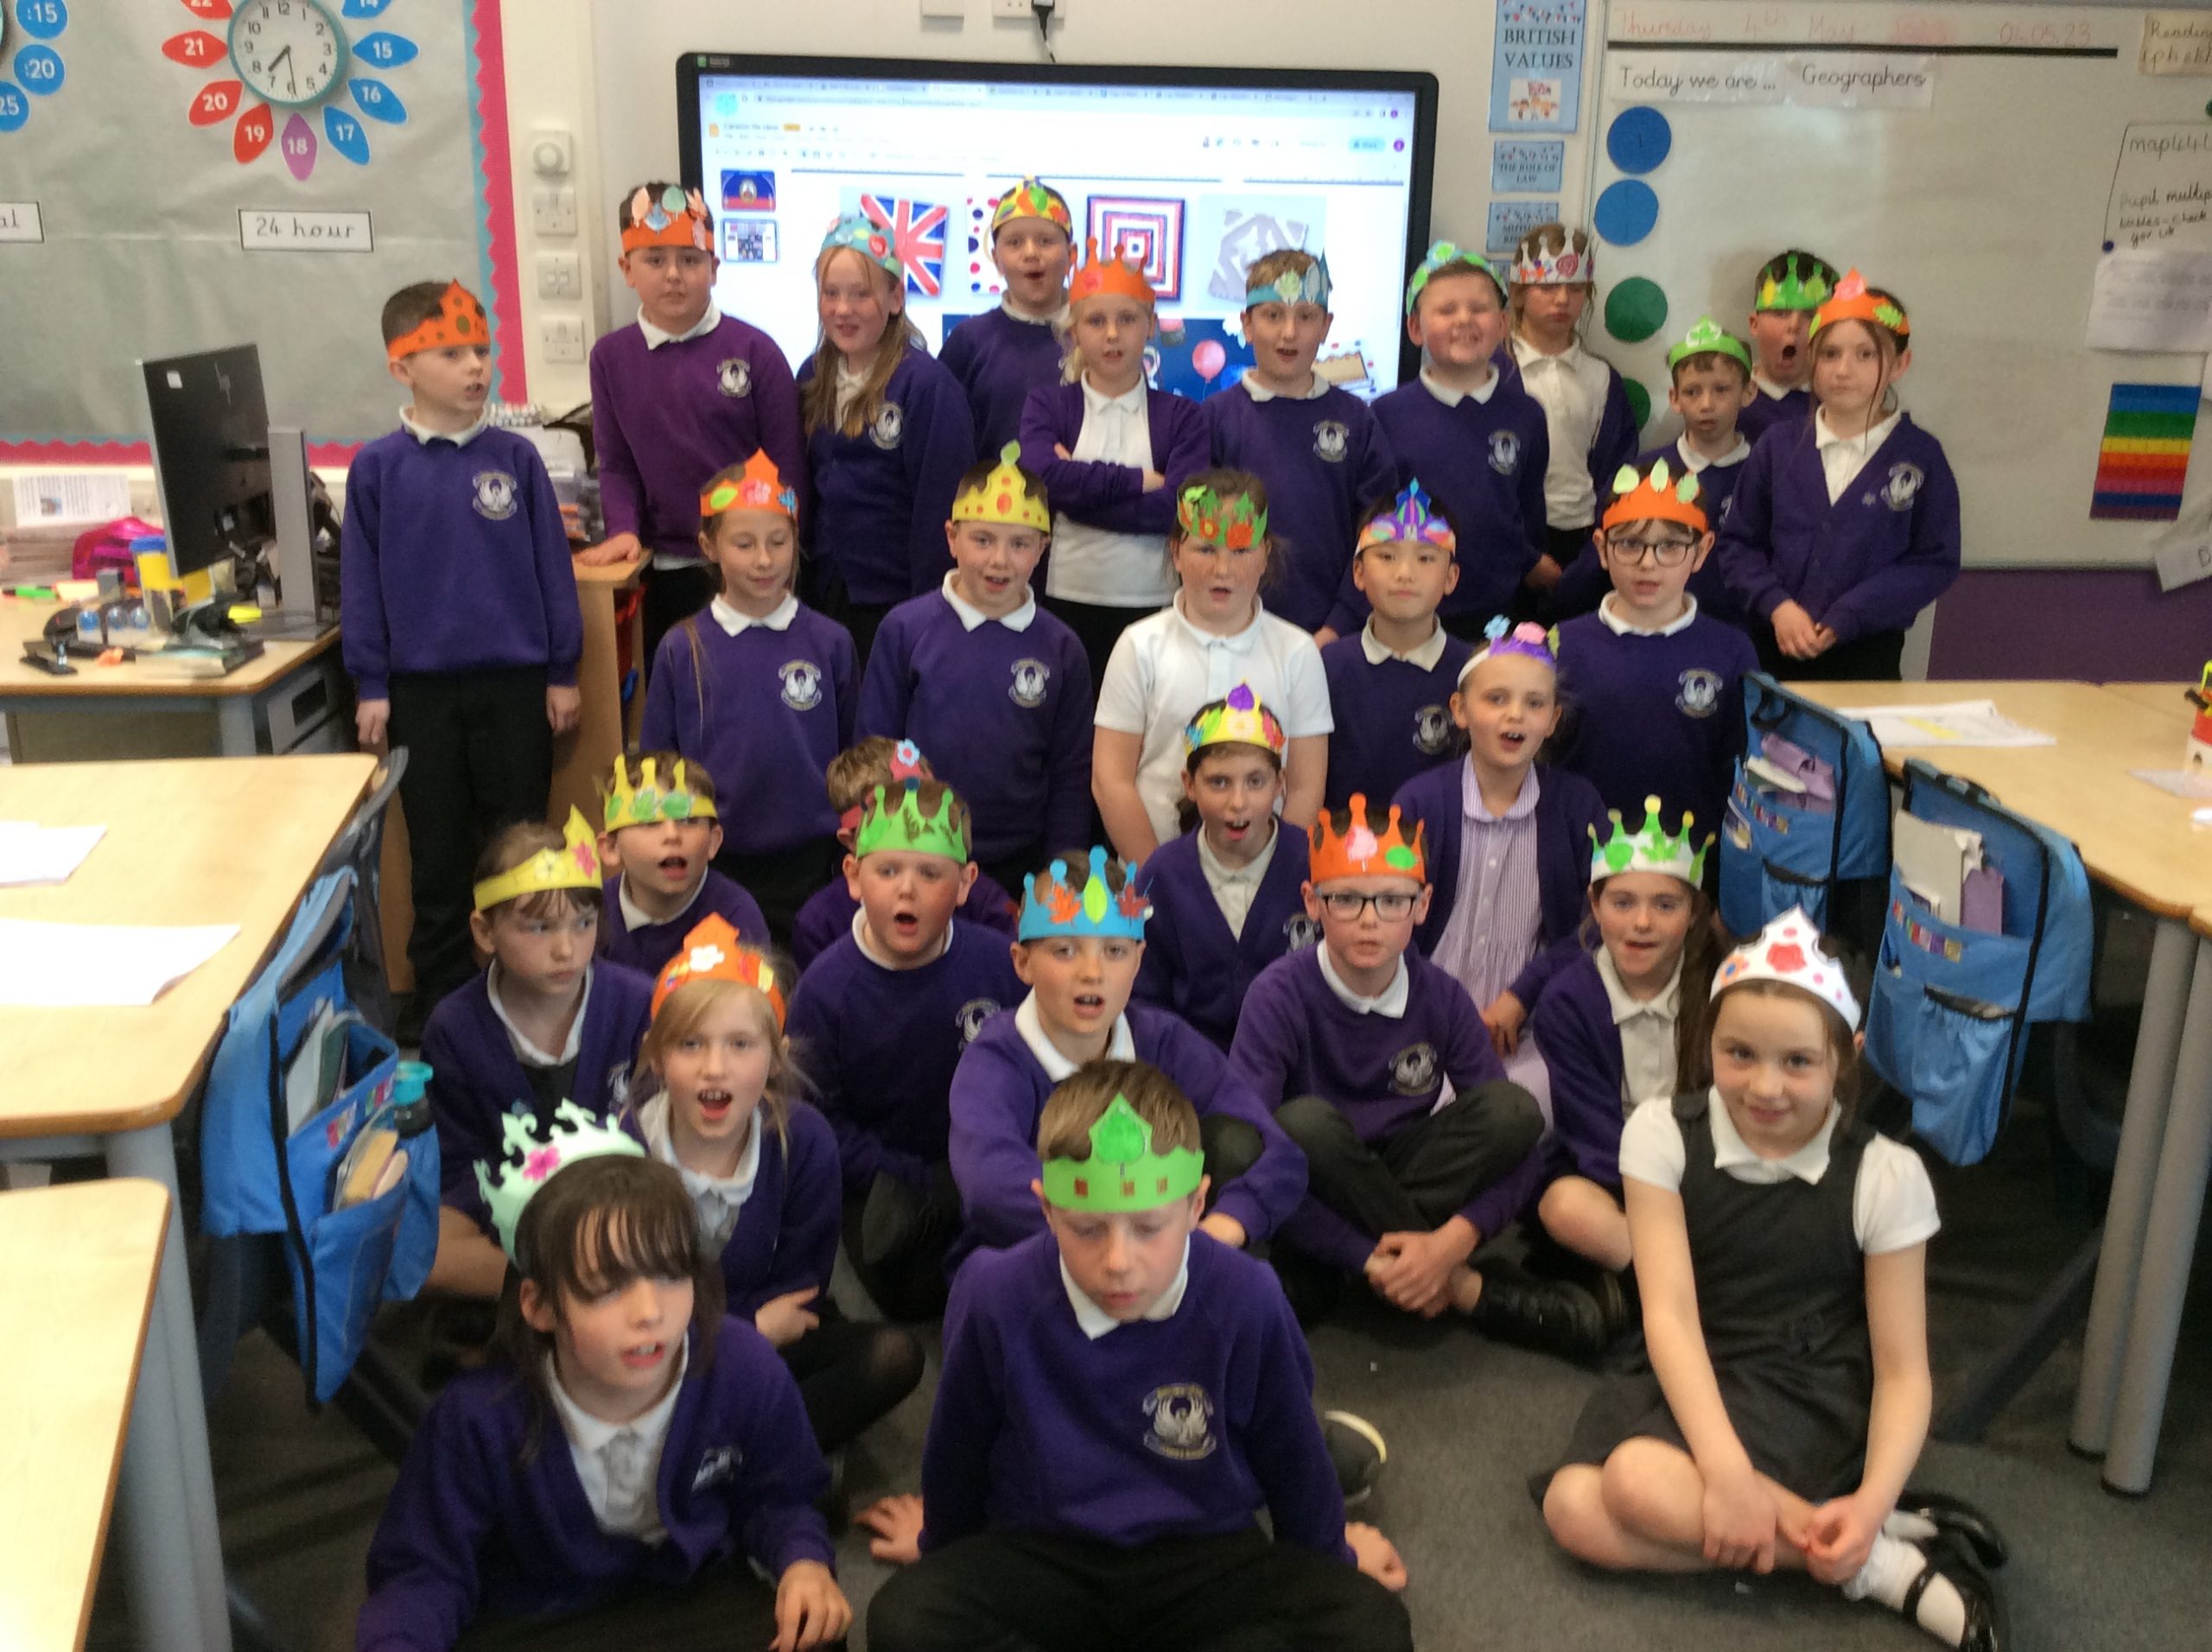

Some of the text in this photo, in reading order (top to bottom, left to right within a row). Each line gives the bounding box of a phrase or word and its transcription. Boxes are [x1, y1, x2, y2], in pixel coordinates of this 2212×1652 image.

[262, 7, 270, 19] 11
[278, 1, 290, 16] 12
[302, 8, 307, 21] 1
[248, 21, 261, 35] 10
[315, 22, 326, 36] 2
[1614, 10, 1713, 40] Thursday
[1807, 16, 1855, 41] May
[1503, 29, 1575, 45] BRITISH
[183, 38, 204, 56] 21
[245, 41, 254, 54] 9
[323, 42, 332, 56] 3
[373, 41, 393, 60] 15
[252, 60, 262, 73] 8
[1504, 53, 1573, 69] VALUES
[319, 62, 327, 76] 4
[268, 73, 276, 88] 7
[306, 75, 316, 90] 5
[1619, 65, 1684, 96] Today
[1689, 74, 1719, 88] we
[1802, 63, 1927, 93] Geographers
[361, 86, 382, 103] 16
[202, 94, 227, 111] 20
[245, 125, 264, 143] 19
[335, 124, 354, 143] 17
[287, 137, 308, 156] 18
[1516, 175, 1537, 184] LAW
[256, 215, 356, 238] 24 hour
